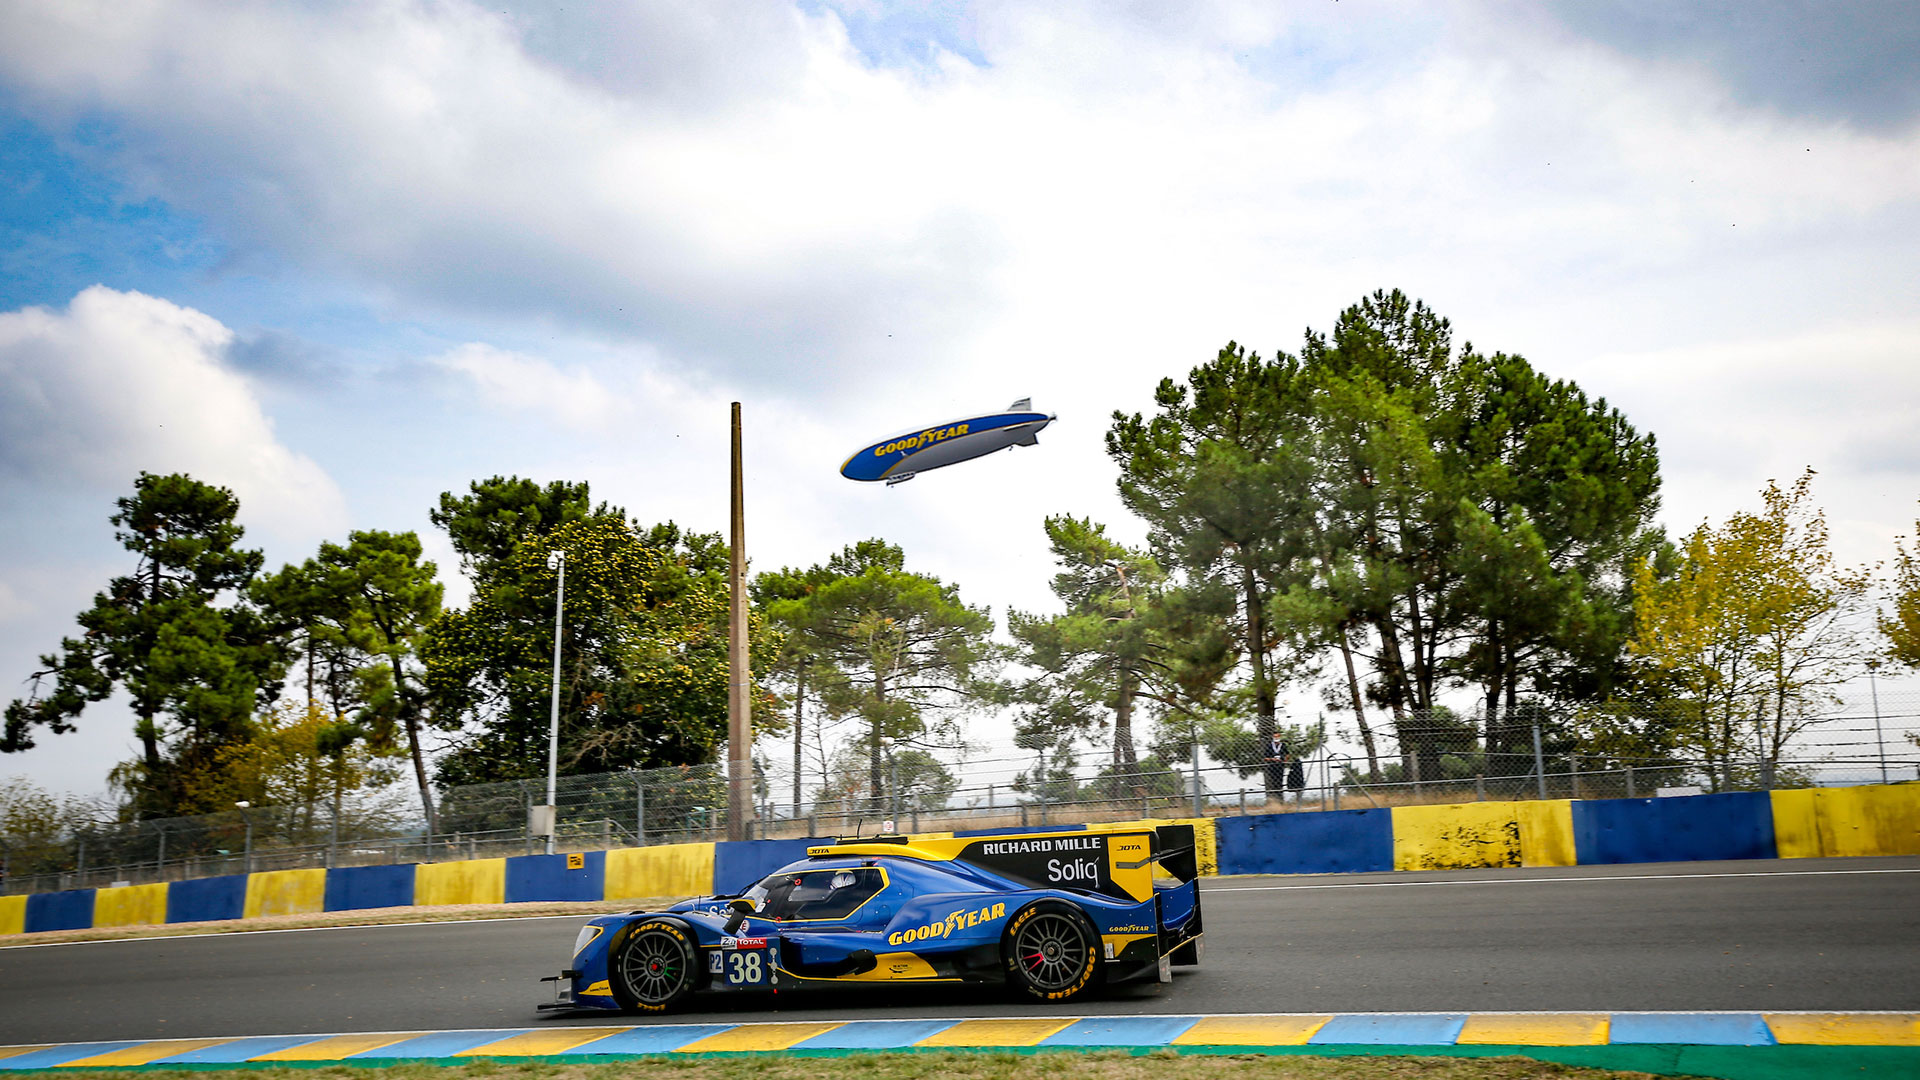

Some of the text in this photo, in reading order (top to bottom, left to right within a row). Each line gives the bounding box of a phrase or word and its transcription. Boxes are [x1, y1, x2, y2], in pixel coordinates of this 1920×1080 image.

[874, 424, 969, 457] GOODYEAR
[983, 837, 1101, 856] RICHARD MILLE
[1116, 844, 1142, 852] JOTA
[1047, 856, 1100, 889] Soliq
[629, 922, 685, 941] GOODYEAR
[888, 902, 1006, 946] GOODYEAR
[1010, 907, 1037, 937] EAGLE
[1109, 925, 1150, 934] GOODYEAR
[709, 953, 722, 970] P2
[728, 952, 762, 984] 38
[1047, 946, 1096, 999] GOODYEAR
